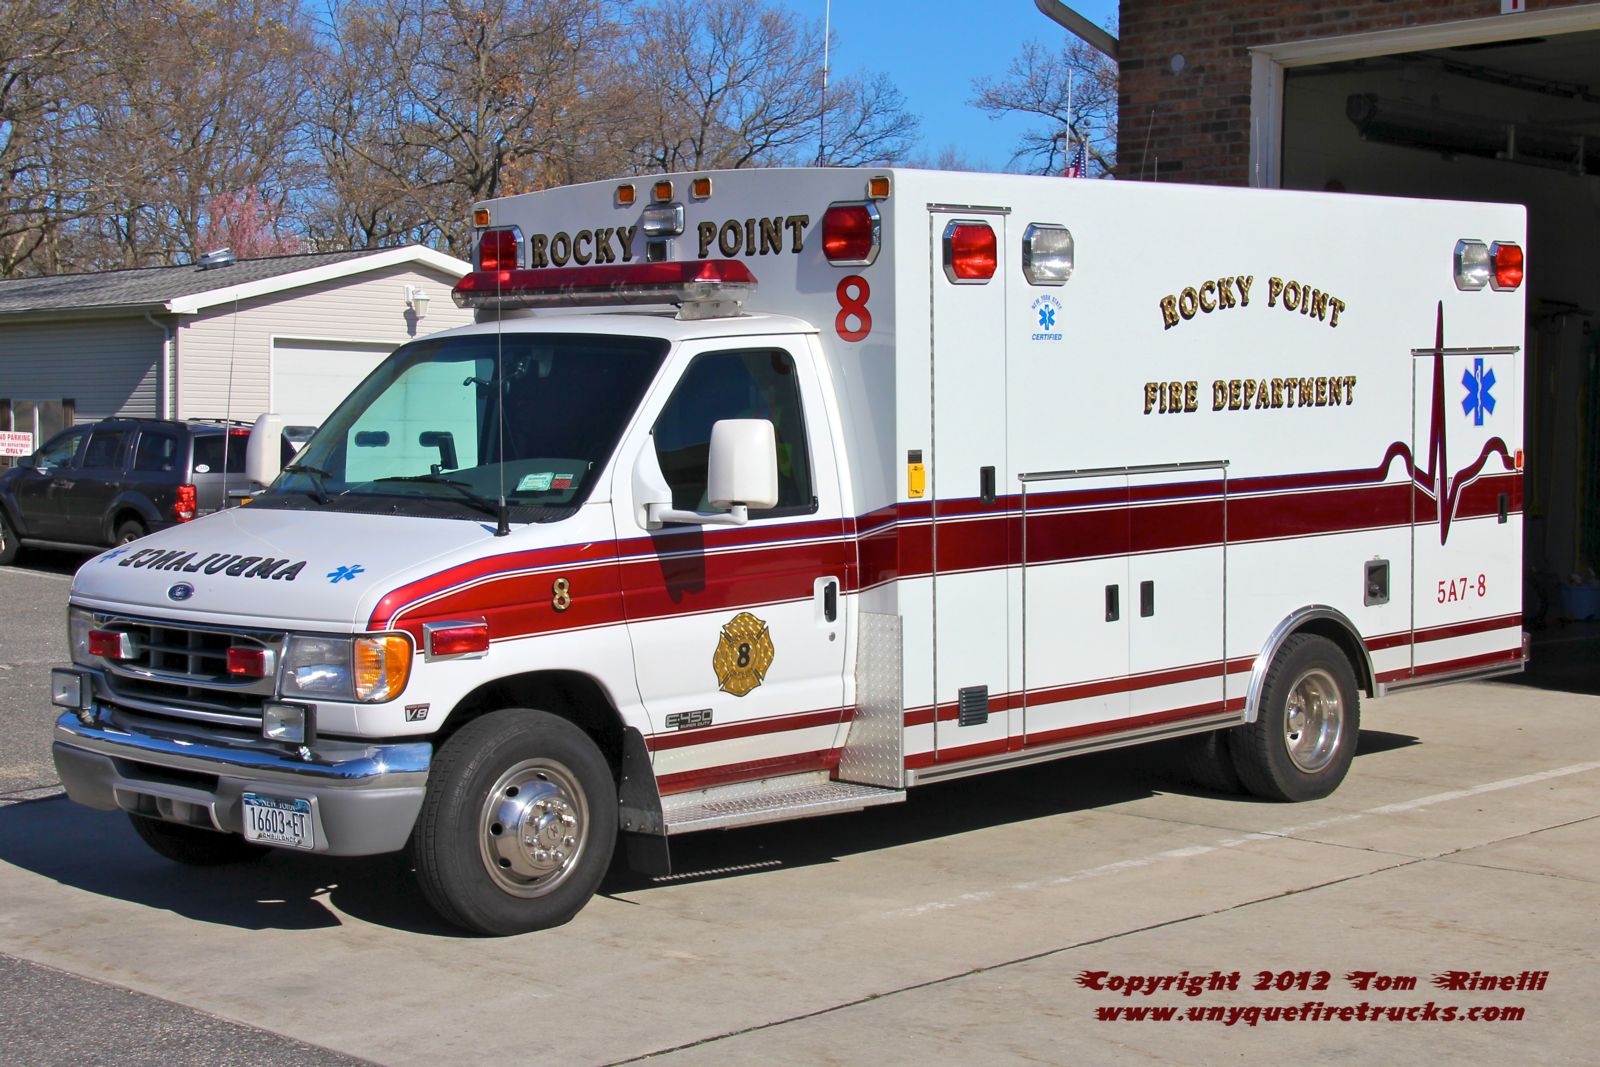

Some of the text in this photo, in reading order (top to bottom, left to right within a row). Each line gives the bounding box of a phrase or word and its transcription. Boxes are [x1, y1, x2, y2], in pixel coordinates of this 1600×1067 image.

[530, 215, 809, 268] ROCKY POINT
[835, 275, 872, 342] 8
[1159, 275, 1345, 330] ROCKY POINT
[1031, 333, 1063, 341] CERTIFIED
[1143, 375, 1357, 415] FIRE DEPARTMENT
[551, 577, 571, 611] 8
[1437, 574, 1486, 604] 5A7-8
[737, 642, 751, 668] 8
[406, 708, 428, 721] V8
